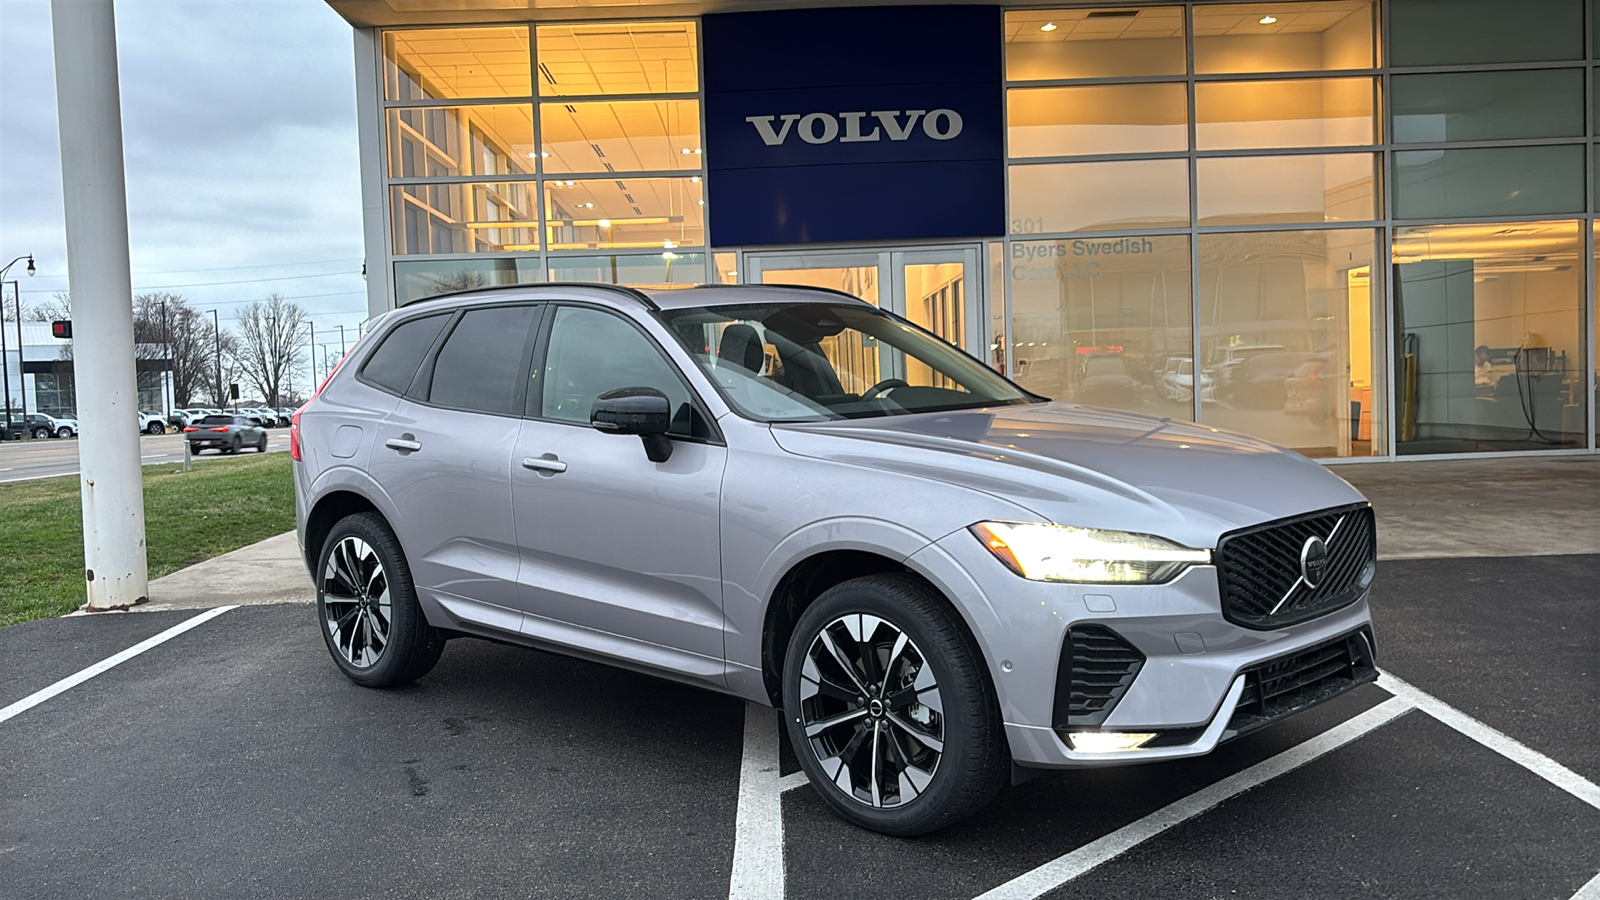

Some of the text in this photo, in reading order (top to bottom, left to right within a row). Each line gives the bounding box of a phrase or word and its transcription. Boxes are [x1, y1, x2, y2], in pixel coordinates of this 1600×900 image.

[746, 109, 963, 146] VOLVO
[1012, 217, 1044, 234] 301
[1012, 238, 1153, 263] Byers Swedish
[1063, 261, 1101, 279] LLC
